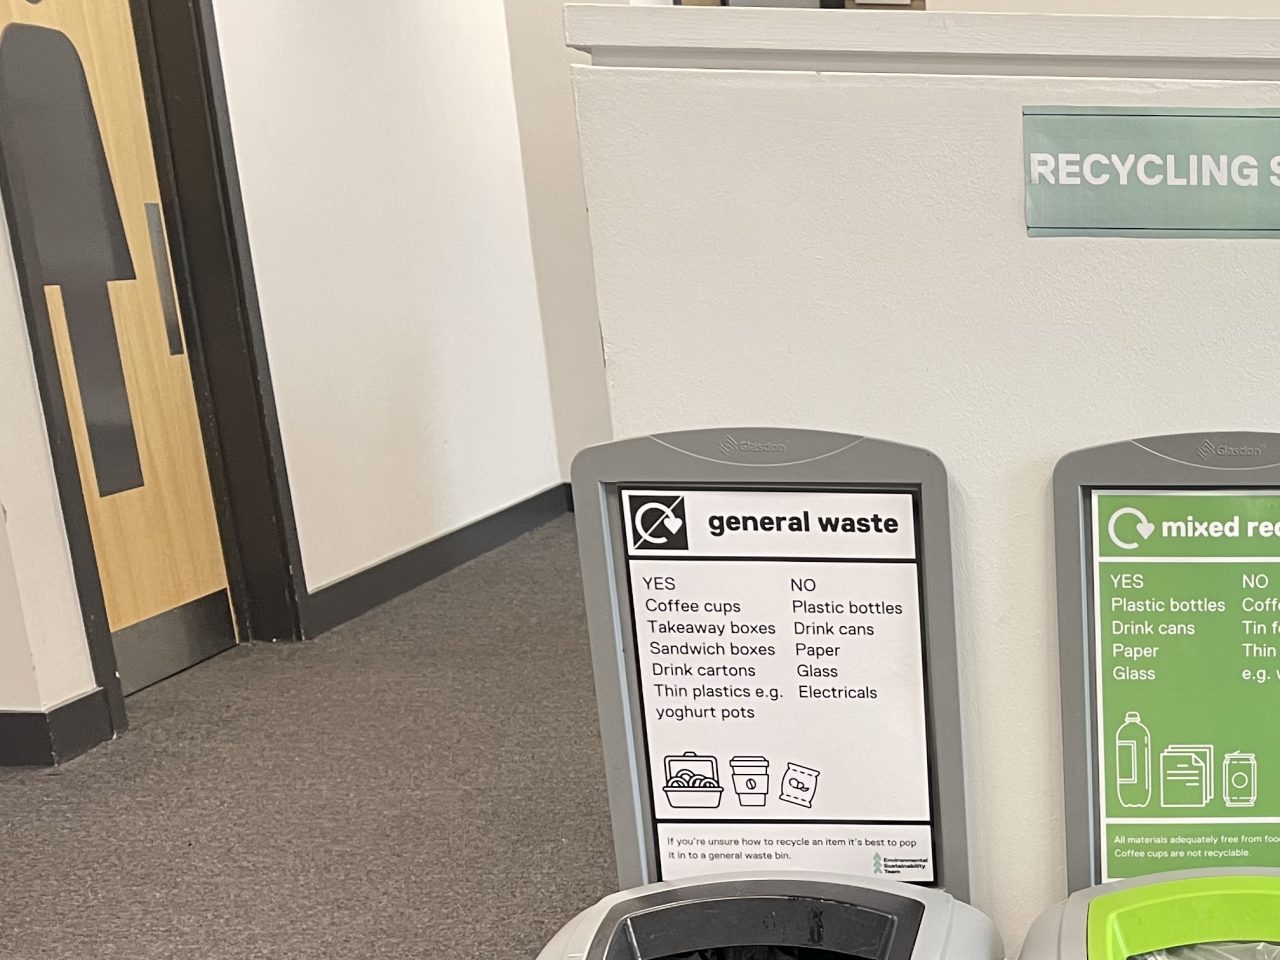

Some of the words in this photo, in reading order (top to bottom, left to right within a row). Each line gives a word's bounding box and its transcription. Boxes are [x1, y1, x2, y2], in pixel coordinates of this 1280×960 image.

[1030, 153, 1258, 186] RECYCLING
[709, 511, 810, 536] general
[818, 514, 898, 533] waste
[1162, 516, 1239, 537] mixed
[643, 577, 675, 590] YES
[791, 579, 815, 591] NO
[1111, 574, 1143, 588] YES
[1243, 574, 1268, 588] NO
[646, 599, 698, 612] Coffee
[704, 603, 740, 615] cups
[793, 600, 844, 613] Plastic
[849, 601, 902, 614] bottles
[1112, 598, 1165, 611] Plastic
[1170, 598, 1225, 611] bottles
[647, 620, 725, 636] Takeaway
[731, 621, 775, 634] boxes
[794, 622, 834, 635] Drink
[839, 626, 874, 635] cans
[1113, 621, 1153, 634] Drink
[1159, 624, 1195, 634] cans
[1242, 621, 1266, 634] Tin
[650, 642, 725, 655] Sandwich
[730, 643, 775, 655] boxes
[796, 643, 840, 659] Paper
[1113, 644, 1159, 660] Paper
[1242, 644, 1276, 657] Thin
[653, 663, 692, 675] Drink
[698, 666, 755, 676] cartons
[797, 664, 838, 677] Glass
[1113, 666, 1155, 680] Glass
[1242, 670, 1270, 683] e.g.
[654, 684, 687, 696] Thin
[693, 685, 750, 700] plastics
[756, 688, 783, 701] e.g.
[799, 685, 877, 698] Electricals
[656, 706, 716, 721] yoghurt
[722, 708, 754, 721] pots
[667, 838, 674, 846] If
[676, 838, 706, 849] you're
[741, 838, 761, 846] how
[776, 838, 810, 849] recycle
[848, 838, 863, 846] it's
[864, 839, 885, 847] best
[887, 839, 897, 847] to
[899, 840, 917, 850] pop
[1114, 835, 1125, 845] All
[1127, 835, 1168, 845] materials
[1169, 835, 1218, 847] adequately
[1220, 834, 1239, 844] free
[1240, 834, 1262, 844] from
[708, 852, 742, 862] general
[775, 852, 792, 860] bin.
[1114, 849, 1145, 858] Coffee
[1147, 850, 1168, 859] cups
[1187, 849, 1202, 857] not
[1204, 848, 1250, 859] recyclable.
